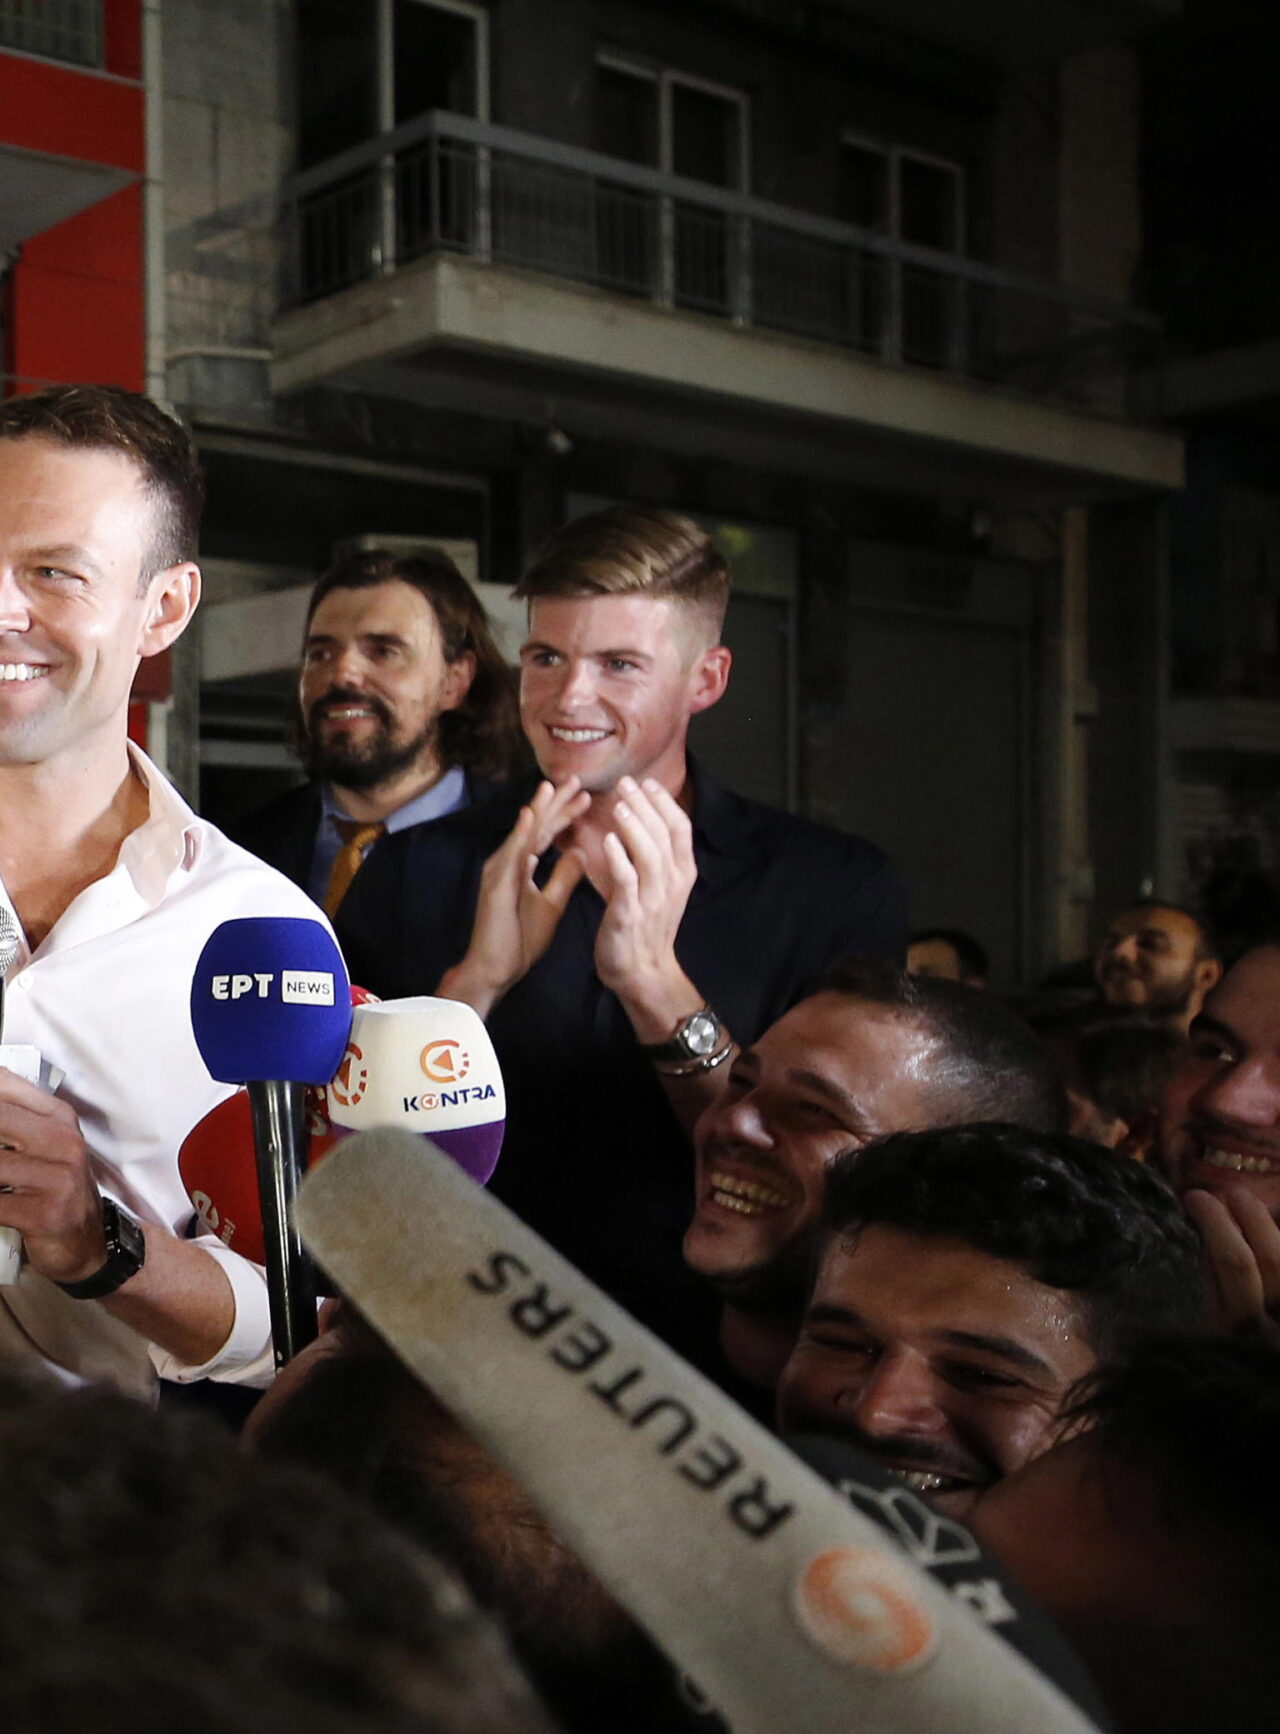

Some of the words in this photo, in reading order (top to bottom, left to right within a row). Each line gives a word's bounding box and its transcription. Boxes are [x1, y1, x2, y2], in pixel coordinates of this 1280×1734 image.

[211, 973, 273, 1000] ΕΡΤ
[286, 981, 330, 995] NEWS
[403, 1084, 496, 1112] KONTRA
[467, 1250, 797, 1542] REUTERS
